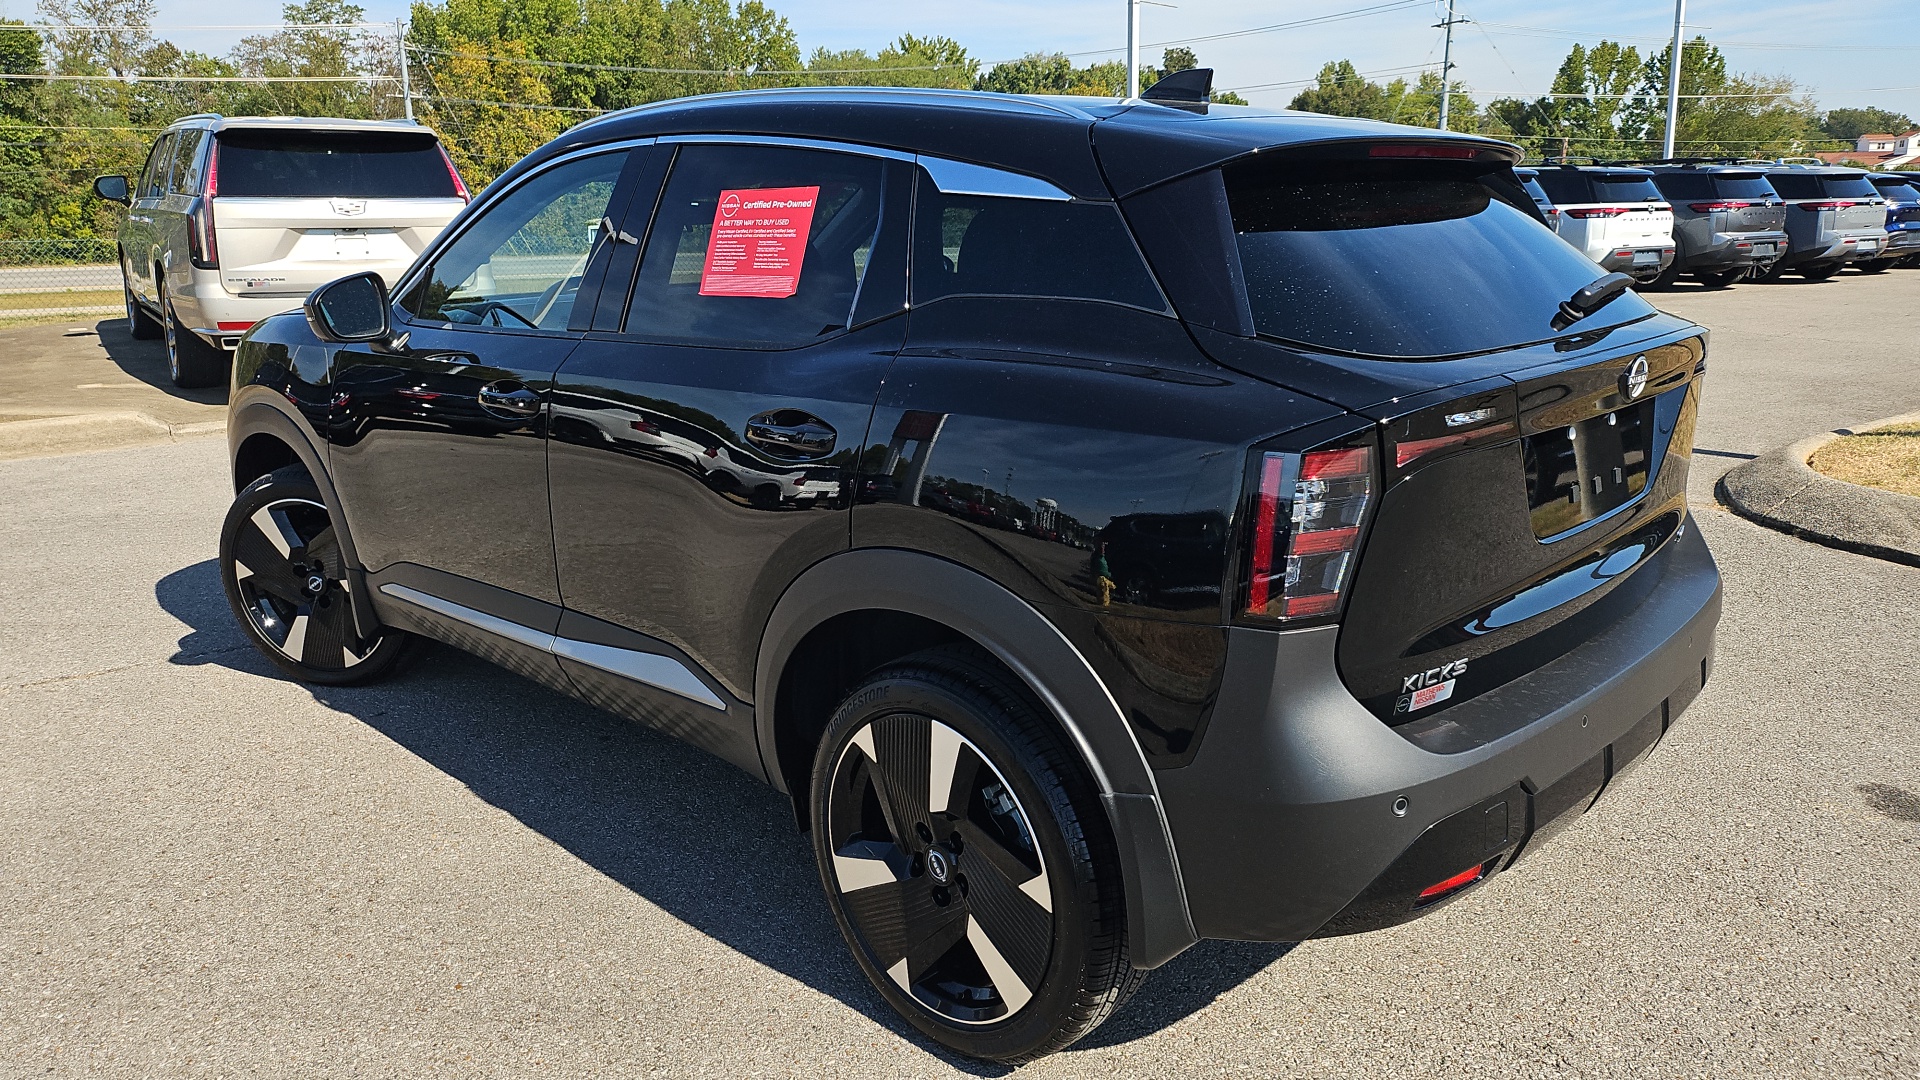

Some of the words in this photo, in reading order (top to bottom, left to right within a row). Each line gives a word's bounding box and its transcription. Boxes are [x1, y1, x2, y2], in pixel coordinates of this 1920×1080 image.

[743, 200, 772, 209] Certified
[771, 199, 813, 209] Pre-Owned
[724, 219, 743, 227] BETTER
[774, 218, 790, 226] USED
[1401, 657, 1469, 693] KICKS
[1415, 683, 1446, 698] MATHEWS
[1414, 693, 1437, 706] NISSAN
[826, 685, 890, 736] BRIDGESTONE
